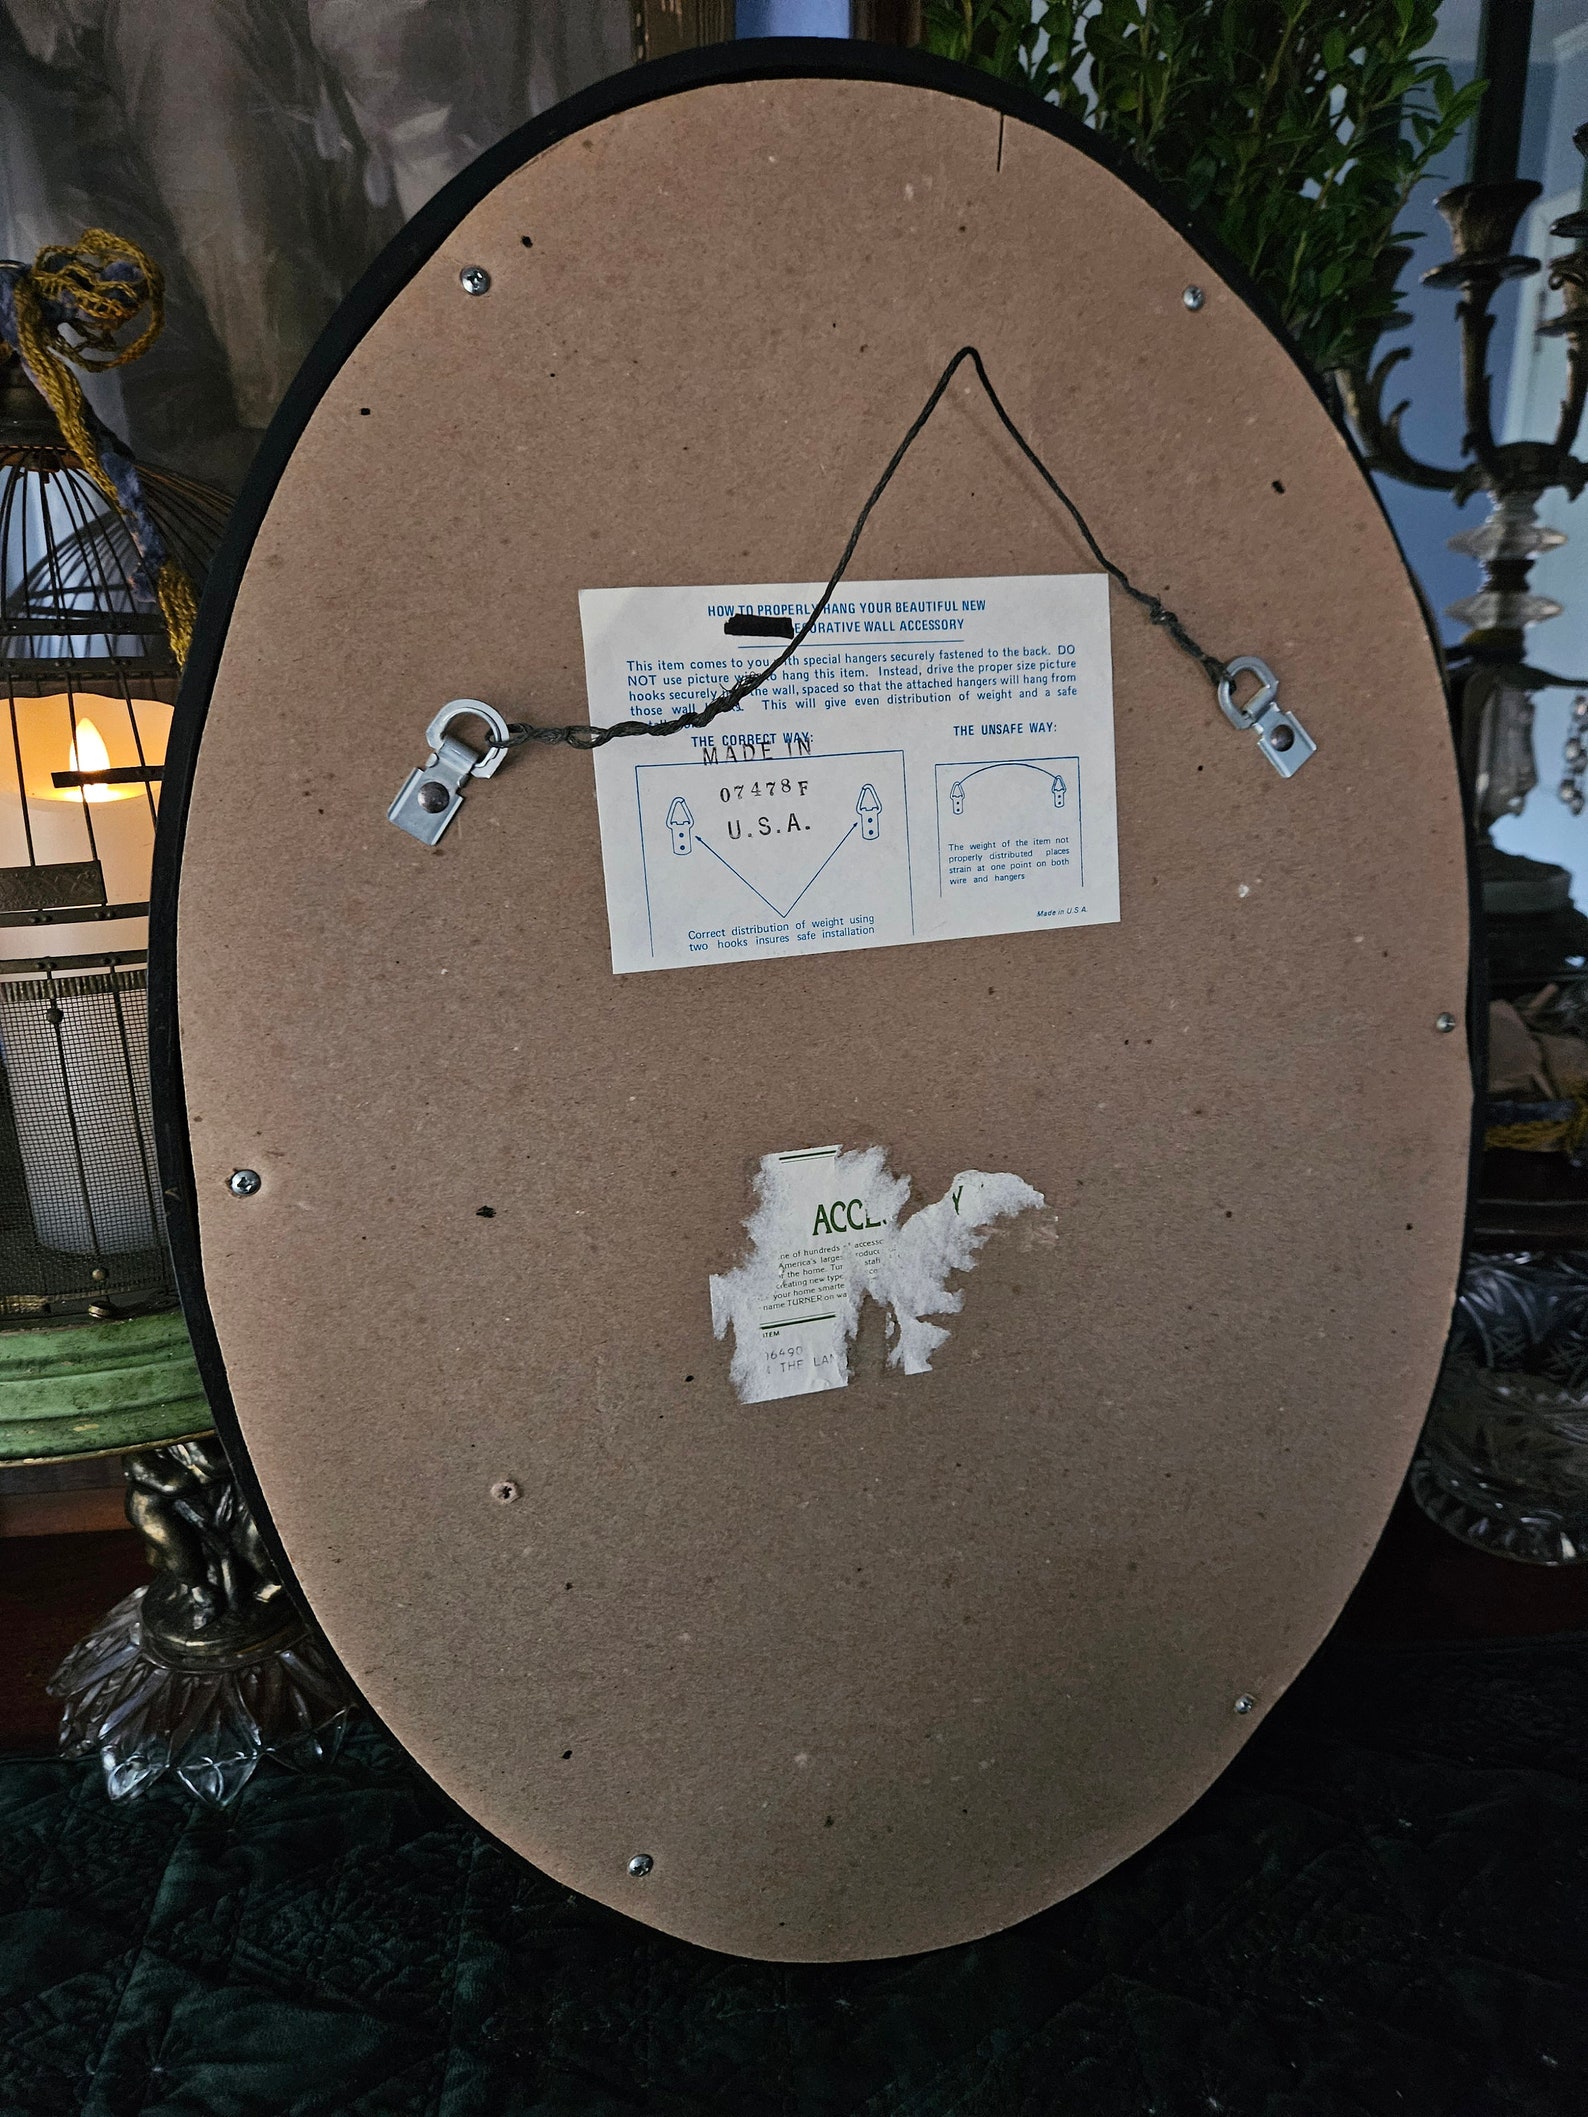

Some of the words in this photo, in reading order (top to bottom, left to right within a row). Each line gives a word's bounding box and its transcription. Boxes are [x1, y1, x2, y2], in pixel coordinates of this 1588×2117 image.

[708, 606, 734, 616] HOW
[738, 605, 753, 615] TO
[823, 603, 856, 614] HANG
[859, 602, 892, 613] YOUR
[896, 601, 959, 613] BEAUTIFUL
[962, 600, 986, 611] NEW
[864, 621, 895, 632] WALL
[899, 619, 965, 631] ACCESSORY
[627, 660, 652, 671] This
[658, 660, 684, 670] item
[690, 660, 727, 669] comes
[732, 658, 743, 668] to
[748, 658, 769, 669] you
[803, 654, 841, 665] special
[845, 653, 887, 665] hangers
[890, 650, 935, 662] securely
[939, 648, 984, 660] fastened
[987, 649, 998, 658] to
[1003, 647, 1019, 657] the
[1023, 646, 1051, 656] back.
[1058, 645, 1075, 655] DO
[628, 675, 656, 686] NOT
[663, 676, 682, 685] use
[688, 674, 729, 686] picture
[783, 671, 809, 681] hang
[814, 669, 835, 679] this
[840, 667, 869, 678] item.
[878, 665, 922, 676] Instead,
[927, 664, 953, 674] drive
[957, 663, 974, 673] the
[978, 663, 1012, 674] proper
[1017, 661, 1036, 670] size
[1040, 659, 1076, 671] picture
[629, 691, 665, 701] hooks
[669, 688, 718, 700] securely
[772, 684, 799, 696] wall,
[802, 683, 839, 696] spaced
[843, 684, 855, 692] so
[859, 681, 881, 691] that
[885, 680, 903, 690] the
[906, 678, 953, 689] attached
[957, 677, 997, 688] hangers
[1000, 675, 1019, 685] will
[1023, 674, 1048, 685] hang
[1051, 673, 1076, 683] from
[630, 706, 662, 716] those
[672, 704, 695, 714] wall
[762, 699, 787, 710] This
[795, 698, 816, 709] will
[824, 698, 846, 709] give
[855, 697, 879, 705] even
[887, 694, 951, 704] distribution
[959, 691, 970, 701] of
[977, 689, 1012, 701] weight
[1019, 688, 1038, 698] and
[1045, 689, 1050, 697] a
[1057, 686, 1077, 696] safe
[953, 725, 975, 736] THE
[981, 723, 1023, 735] UNSAFE
[1029, 722, 1057, 733] WAY:
[691, 736, 714, 747] THE
[722, 733, 777, 746] CORRECT
[783, 732, 814, 744] WAY:
[702, 741, 773, 765] MADE
[786, 738, 811, 756] IN
[719, 777, 809, 802] 07478F
[727, 813, 811, 840] U.S.A.
[948, 843, 964, 851] The
[969, 842, 996, 851] weight
[1002, 840, 1010, 848] of
[949, 854, 983, 864] properly
[989, 851, 1033, 860] distributed
[1046, 848, 1070, 856] places
[949, 866, 972, 874] strain
[1010, 861, 1032, 870] point
[1051, 858, 1070, 866] both
[950, 877, 967, 885] wire
[974, 875, 988, 883] and
[994, 873, 1025, 882] hangers
[688, 929, 726, 940] Correct
[731, 922, 789, 936] distribution
[795, 920, 806, 930] of
[811, 917, 844, 929] weight
[849, 915, 875, 925] using
[689, 942, 709, 952] two
[717, 938, 748, 949] hooks
[756, 934, 790, 945] insures
[797, 931, 817, 941] safe
[821, 925, 875, 939] installation
[803, 1246, 840, 1256] hundreds
[773, 1292, 791, 1301] your
[793, 1288, 815, 1296] home
[763, 1303, 785, 1311] name
[788, 1295, 822, 1306] TURNER
